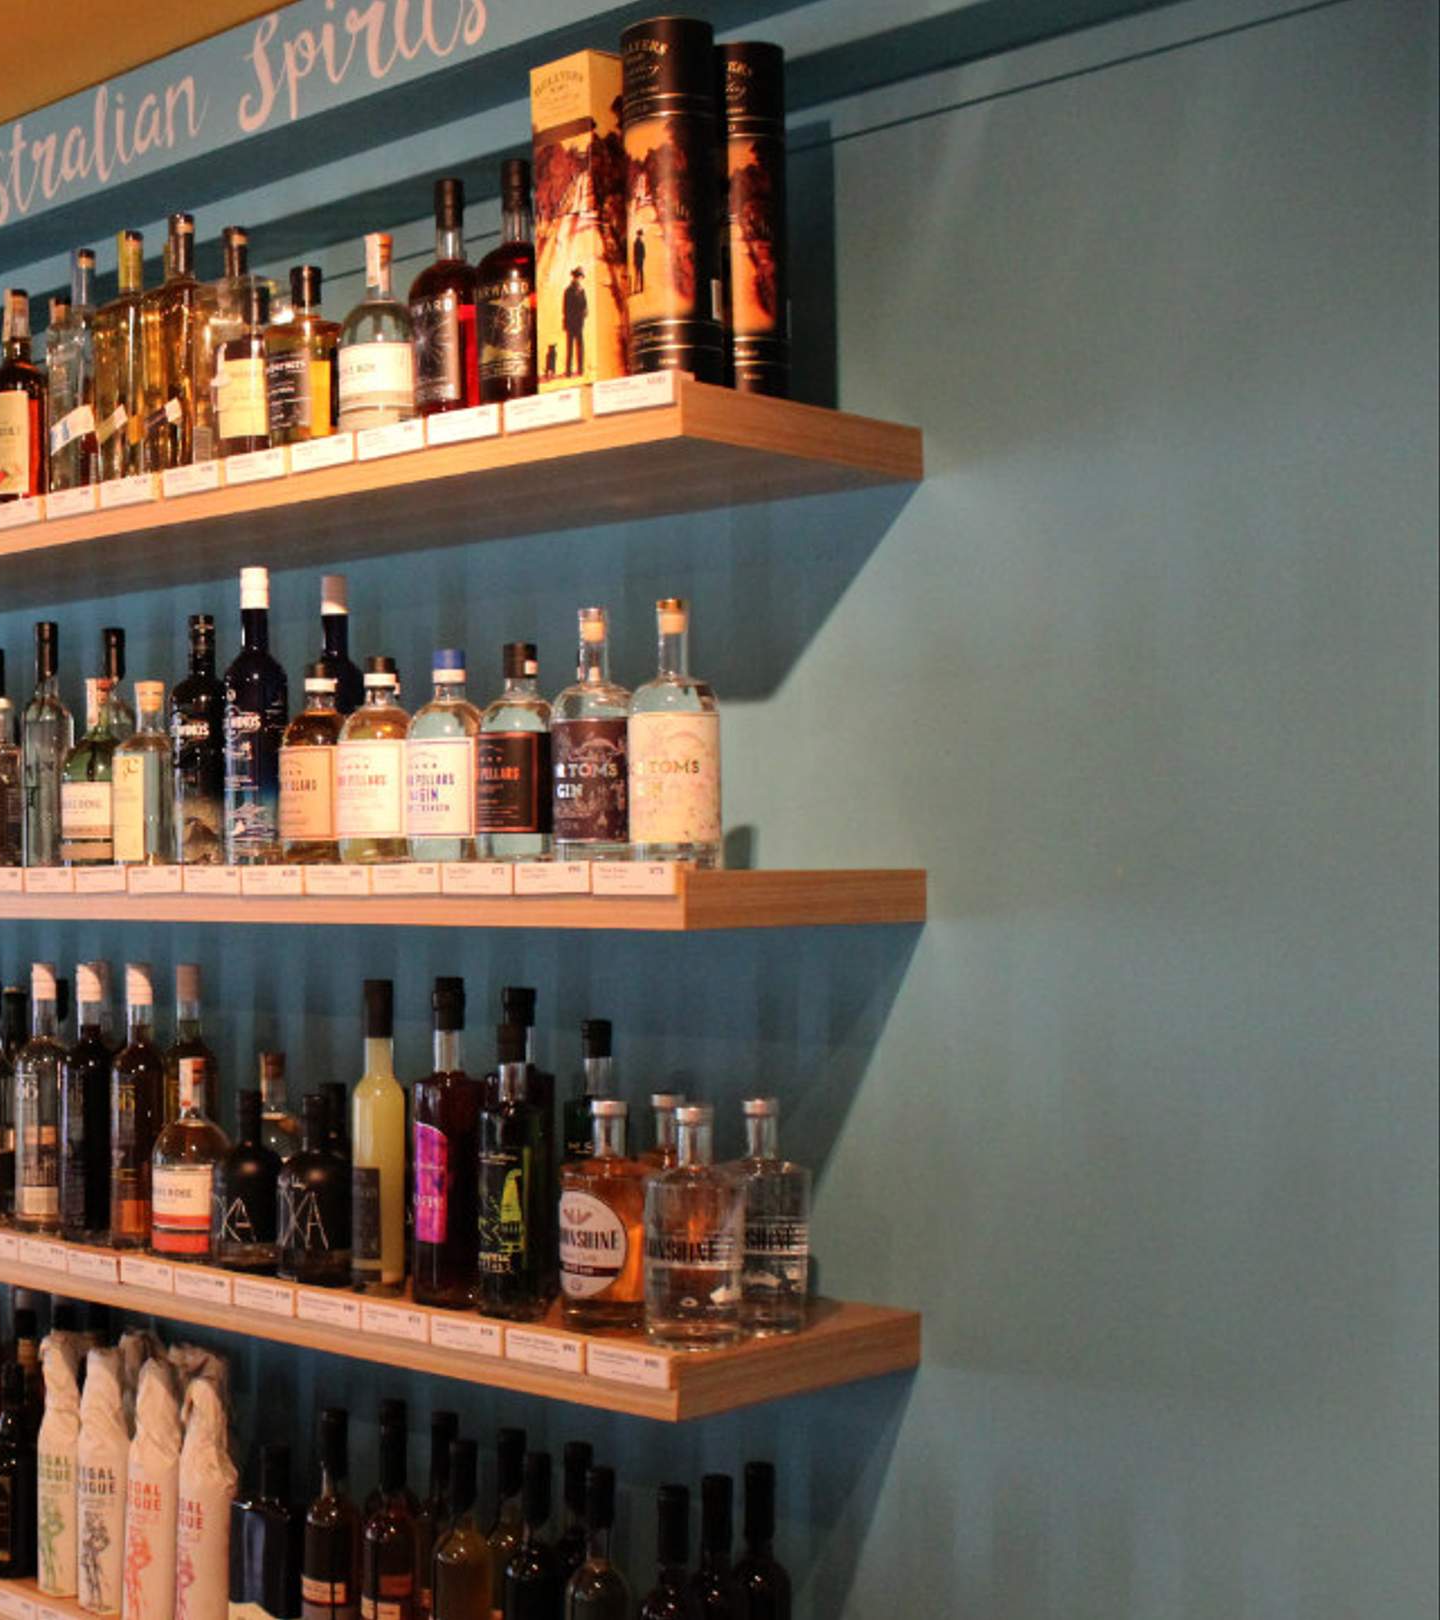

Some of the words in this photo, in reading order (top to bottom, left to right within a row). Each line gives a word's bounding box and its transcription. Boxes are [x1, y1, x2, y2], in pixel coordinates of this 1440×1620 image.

[568, 763, 619, 778] TOMS
[649, 759, 701, 775] TOMS
[557, 783, 584, 799] GIN
